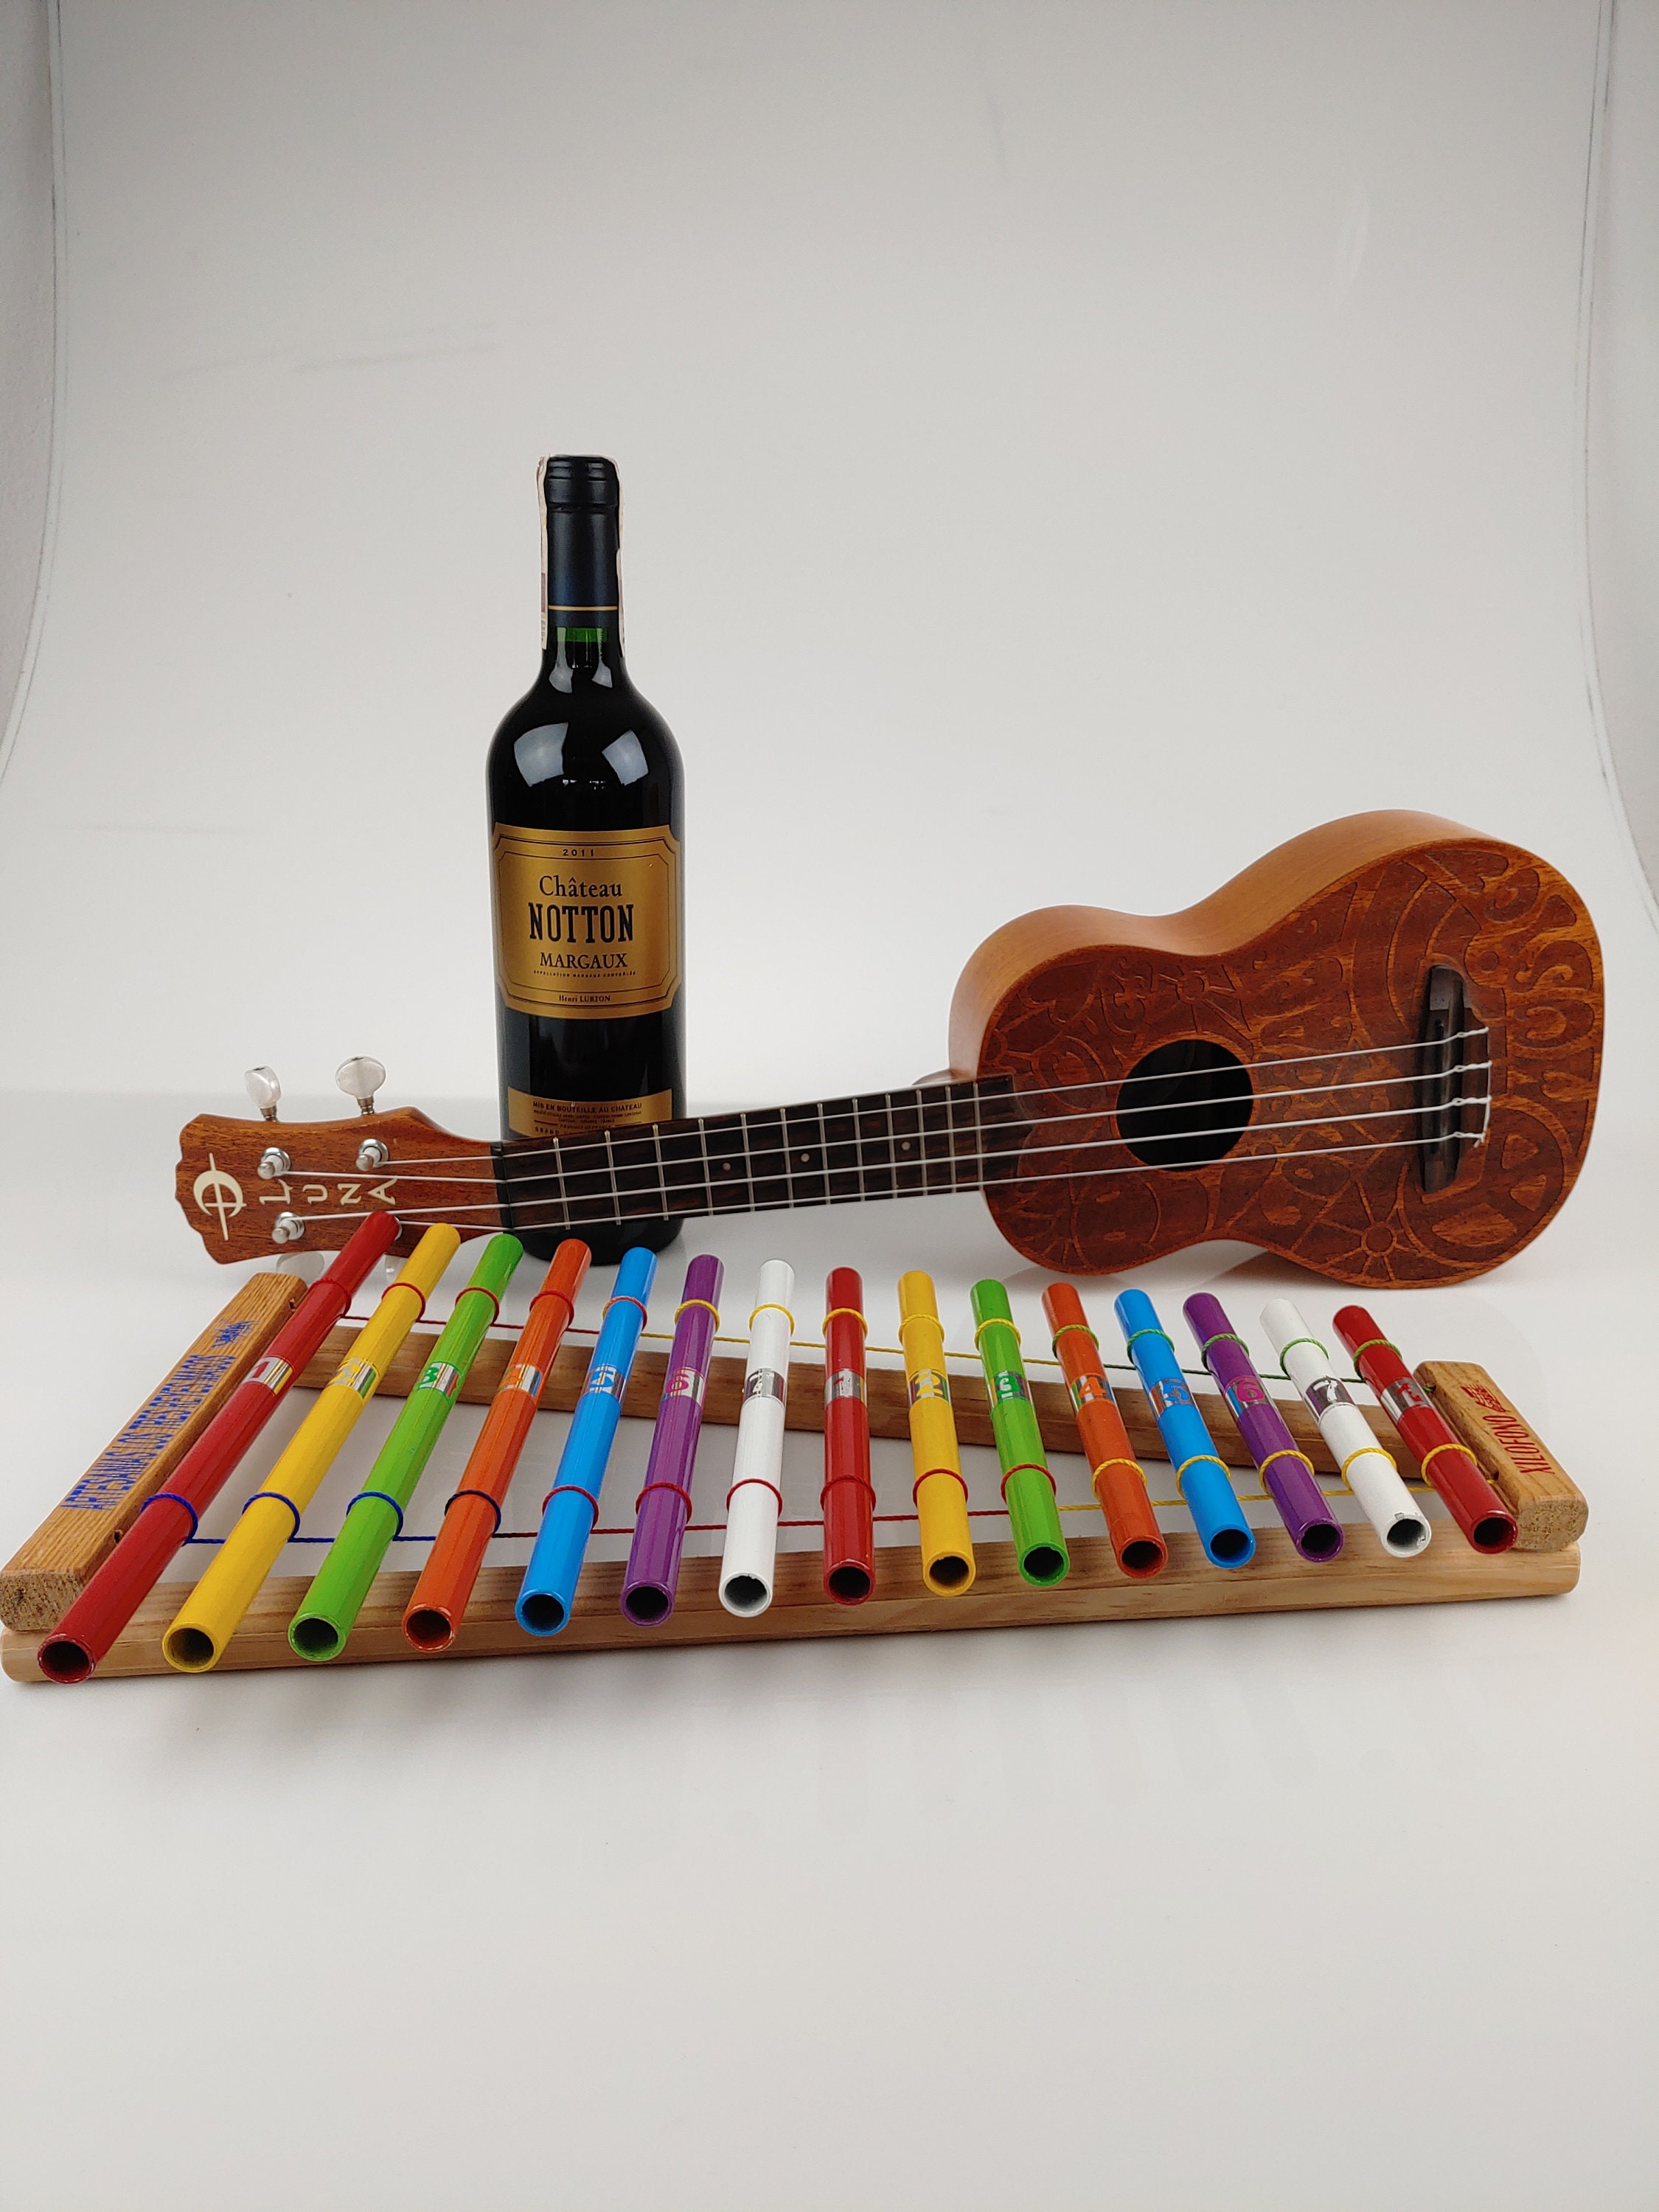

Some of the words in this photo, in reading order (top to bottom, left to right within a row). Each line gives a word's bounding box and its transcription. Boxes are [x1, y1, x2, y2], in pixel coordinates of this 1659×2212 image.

[563, 849, 594, 857] 2011
[539, 874, 622, 897] Château
[528, 902, 634, 944] NOTTON
[540, 952, 627, 970] MARGAUX
[559, 995, 578, 1003] Henri
[580, 995, 611, 1003] LURTON
[532, 1101, 545, 1109] MIS
[259, 1178, 398, 1206] LUNA
[251, 1361, 271, 1378] 1
[415, 1366, 440, 1388] 3
[588, 1369, 615, 1388] 5
[665, 1373, 690, 1394] 6
[915, 1374, 944, 1397] 2
[996, 1374, 1020, 1396] 3
[1079, 1377, 1107, 1399] 4
[1162, 1381, 1190, 1403] 5
[1237, 1380, 1266, 1402] 6
[1312, 1380, 1338, 1402] 7
[1482, 1415, 1556, 1475] XILOFONO
